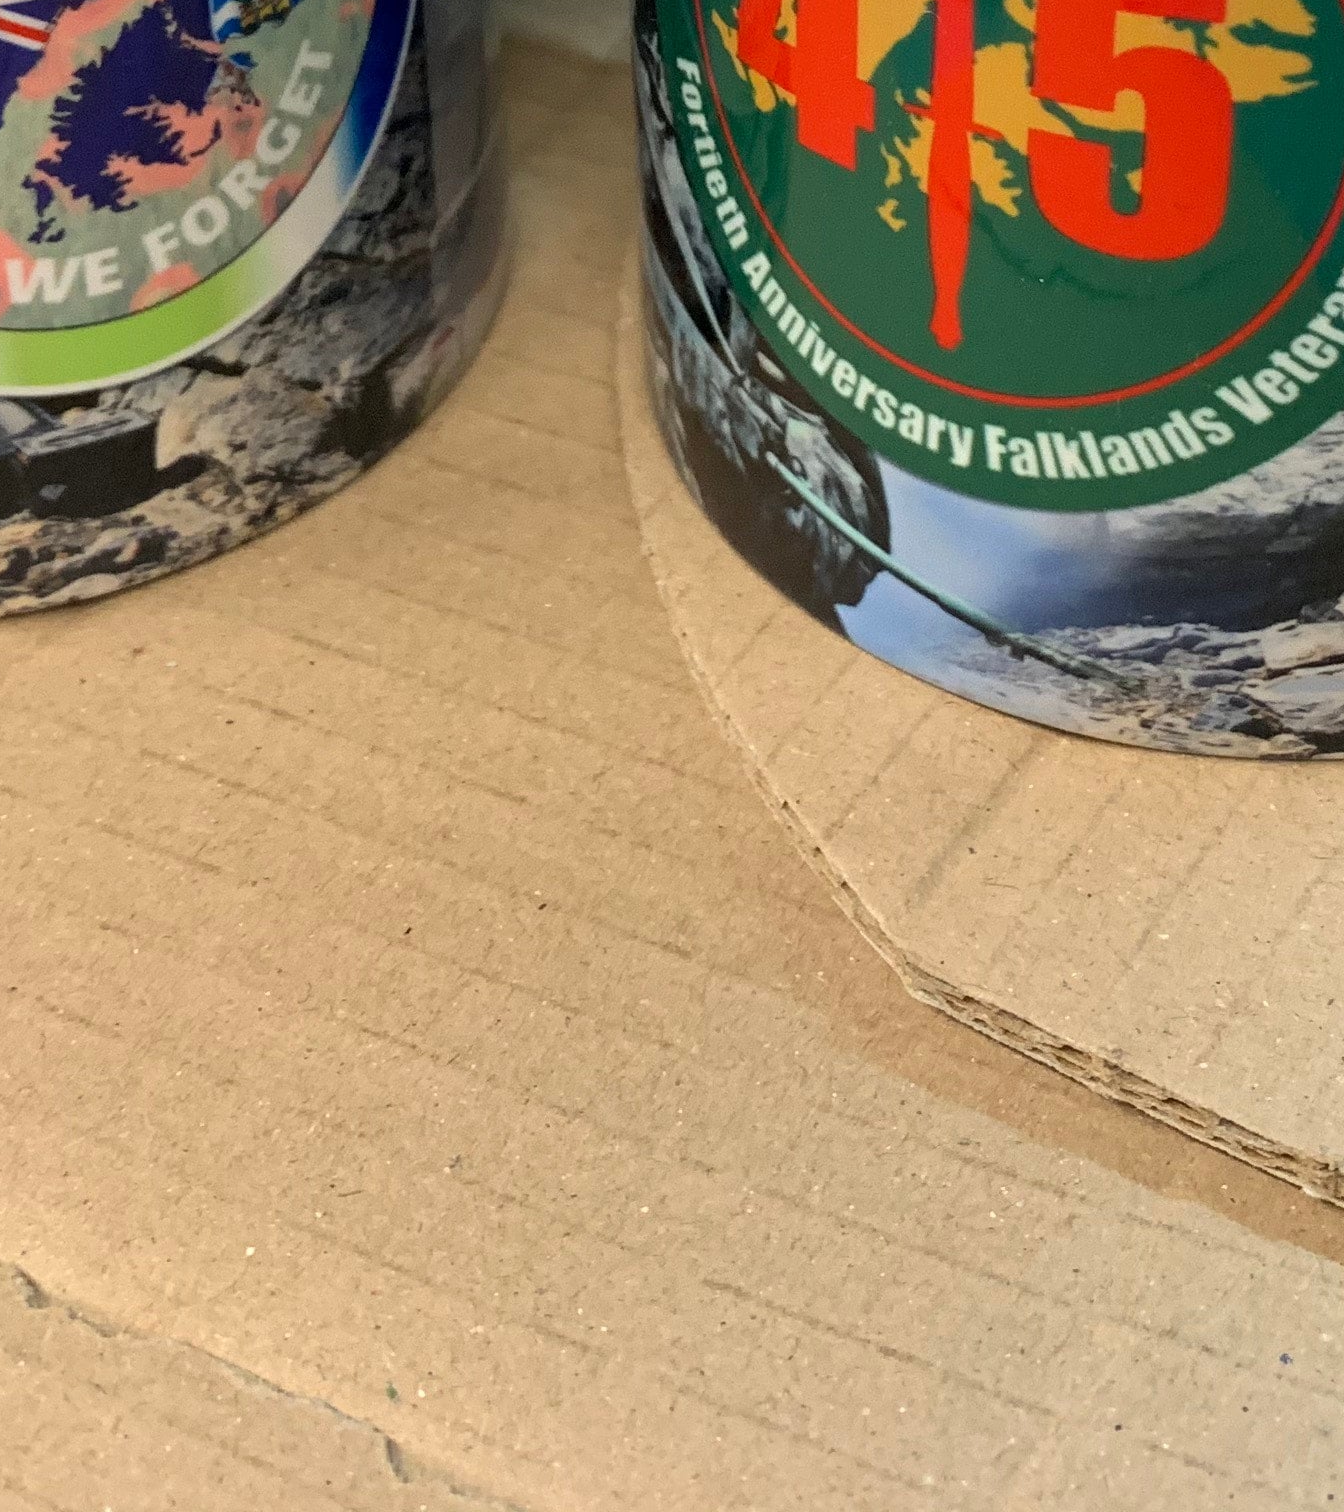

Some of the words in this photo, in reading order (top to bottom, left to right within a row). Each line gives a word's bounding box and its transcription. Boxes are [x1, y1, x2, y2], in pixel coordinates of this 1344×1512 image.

[4, 246, 123, 304] WE
[147, 45, 333, 271] FORGET
[675, 55, 750, 252] Fortieth
[744, 253, 976, 468] Anniversary
[985, 404, 1233, 481] Falklands
